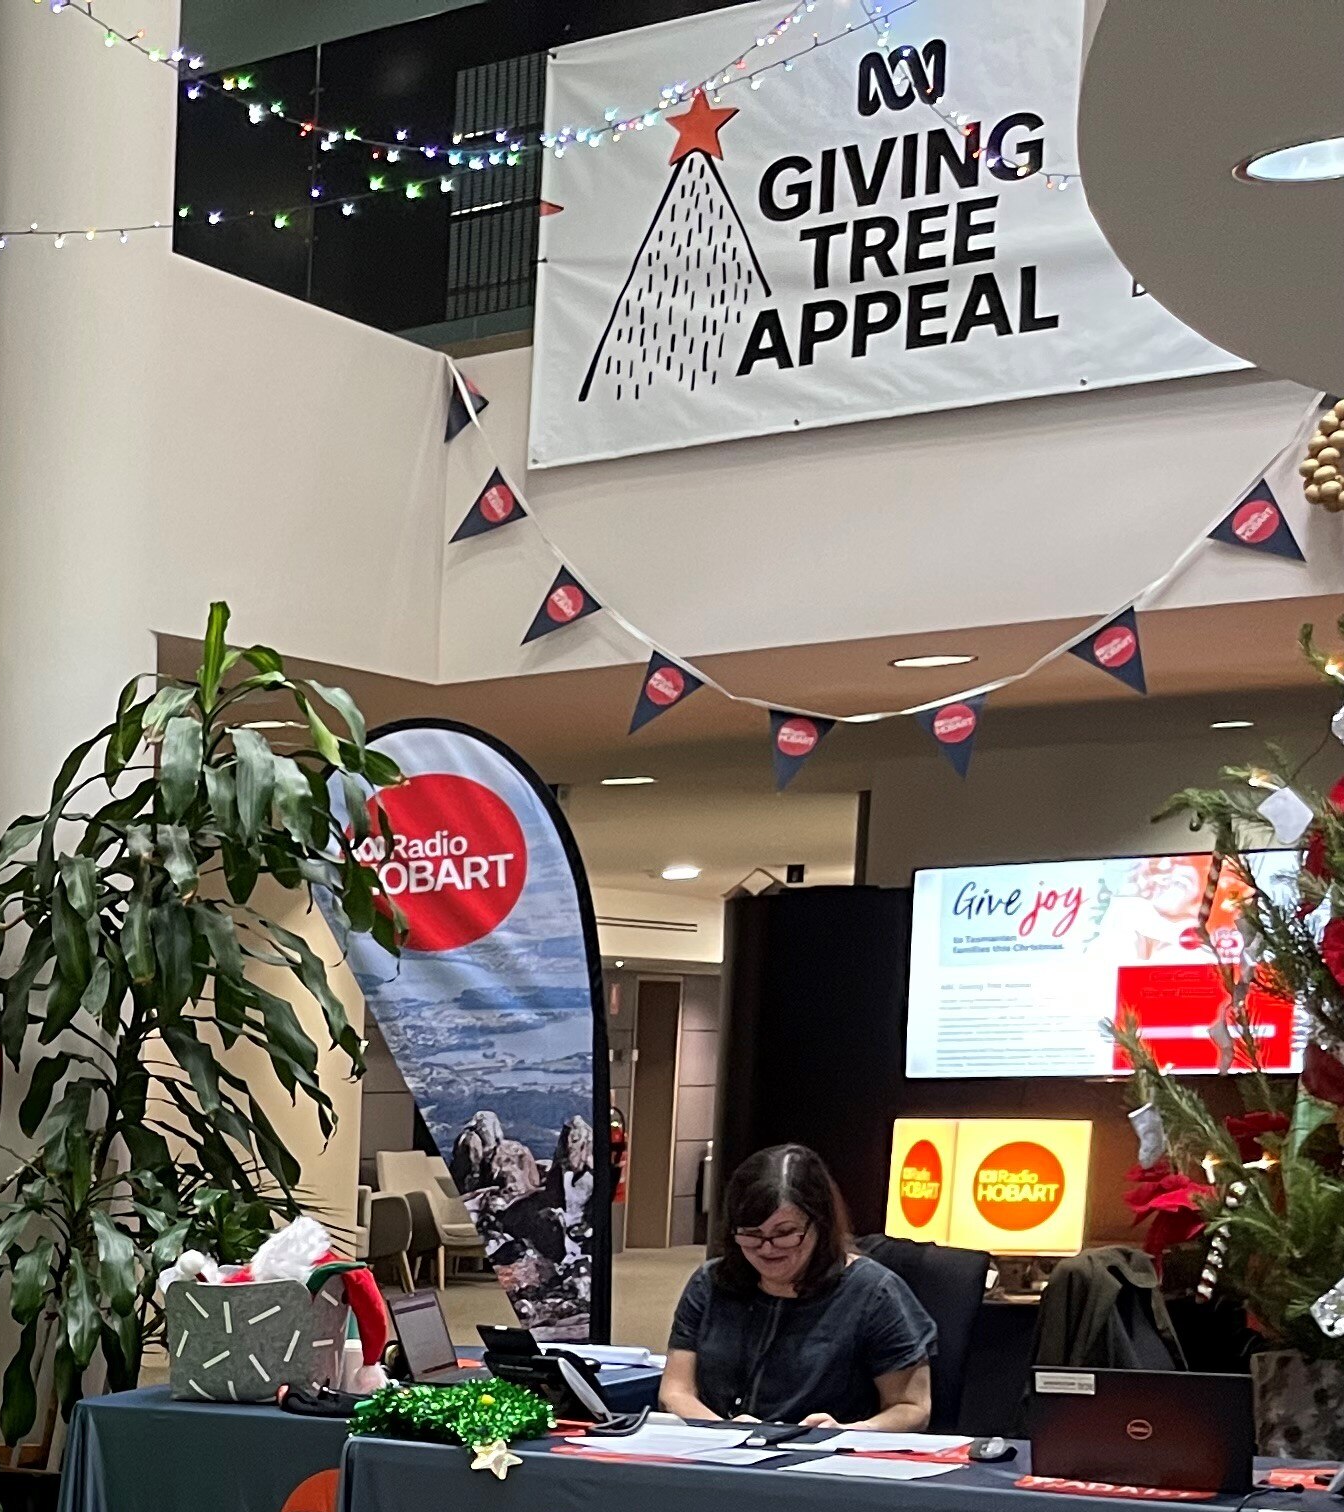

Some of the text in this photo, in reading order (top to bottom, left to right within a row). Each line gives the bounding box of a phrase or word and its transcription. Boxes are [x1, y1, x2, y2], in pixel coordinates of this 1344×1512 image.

[759, 112, 1045, 222] GIVING
[800, 196, 999, 290] TREE
[736, 266, 1059, 377] APPEAL
[391, 830, 468, 860] Radio
[953, 881, 1089, 937] Give joy
[977, 1183, 1060, 1203] HOBART
[998, 1168, 1039, 1184] Radio
